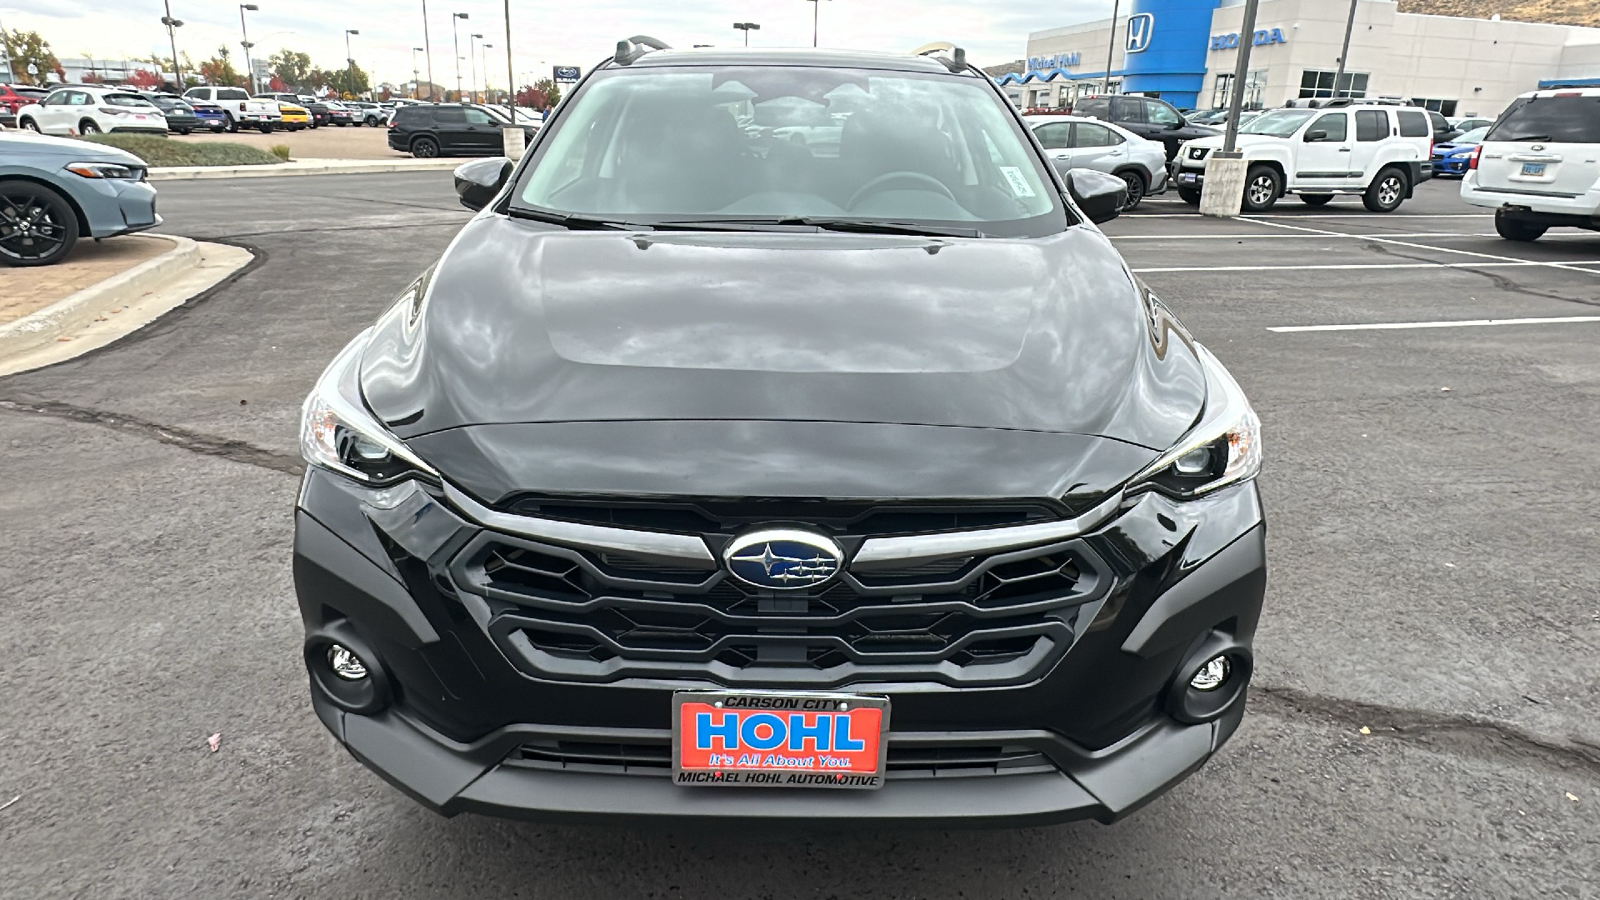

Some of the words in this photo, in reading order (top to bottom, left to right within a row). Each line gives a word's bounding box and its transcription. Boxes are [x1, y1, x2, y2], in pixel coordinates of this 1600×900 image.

[1210, 28, 1286, 51] HODA
[724, 696, 797, 709] CARSON
[802, 698, 841, 710] CITY
[696, 712, 865, 752] HOHL
[708, 753, 733, 766] It's
[737, 754, 760, 766] All
[764, 754, 815, 767] About
[818, 755, 852, 767] You.
[678, 772, 741, 783] MICHAEL
[745, 774, 783, 784] HOHL
[786, 774, 880, 786] AUTOMOTIVE
